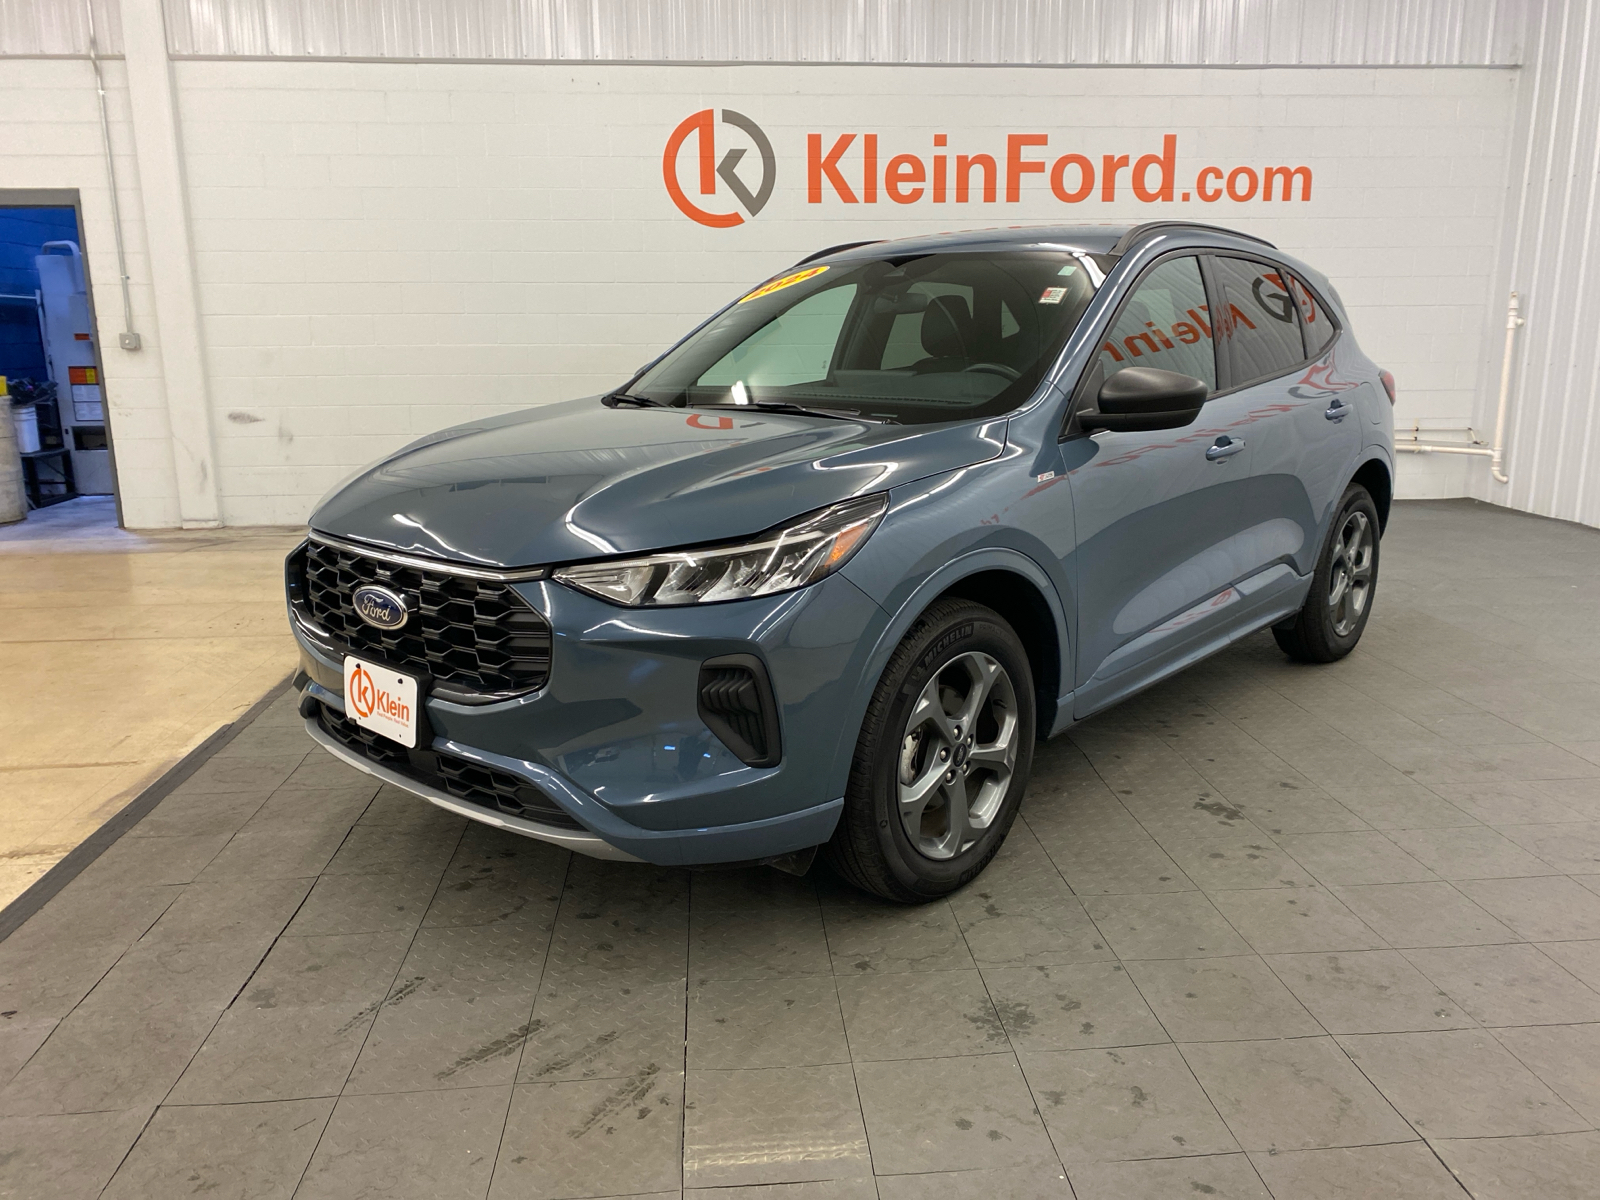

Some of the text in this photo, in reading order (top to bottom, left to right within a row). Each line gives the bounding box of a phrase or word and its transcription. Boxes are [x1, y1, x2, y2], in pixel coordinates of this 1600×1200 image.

[807, 133, 1313, 204] KleinFord.com
[746, 268, 820, 299] 2024
[361, 593, 392, 622] Ford
[924, 625, 973, 667] MICHELIN
[376, 688, 411, 722] Klein
